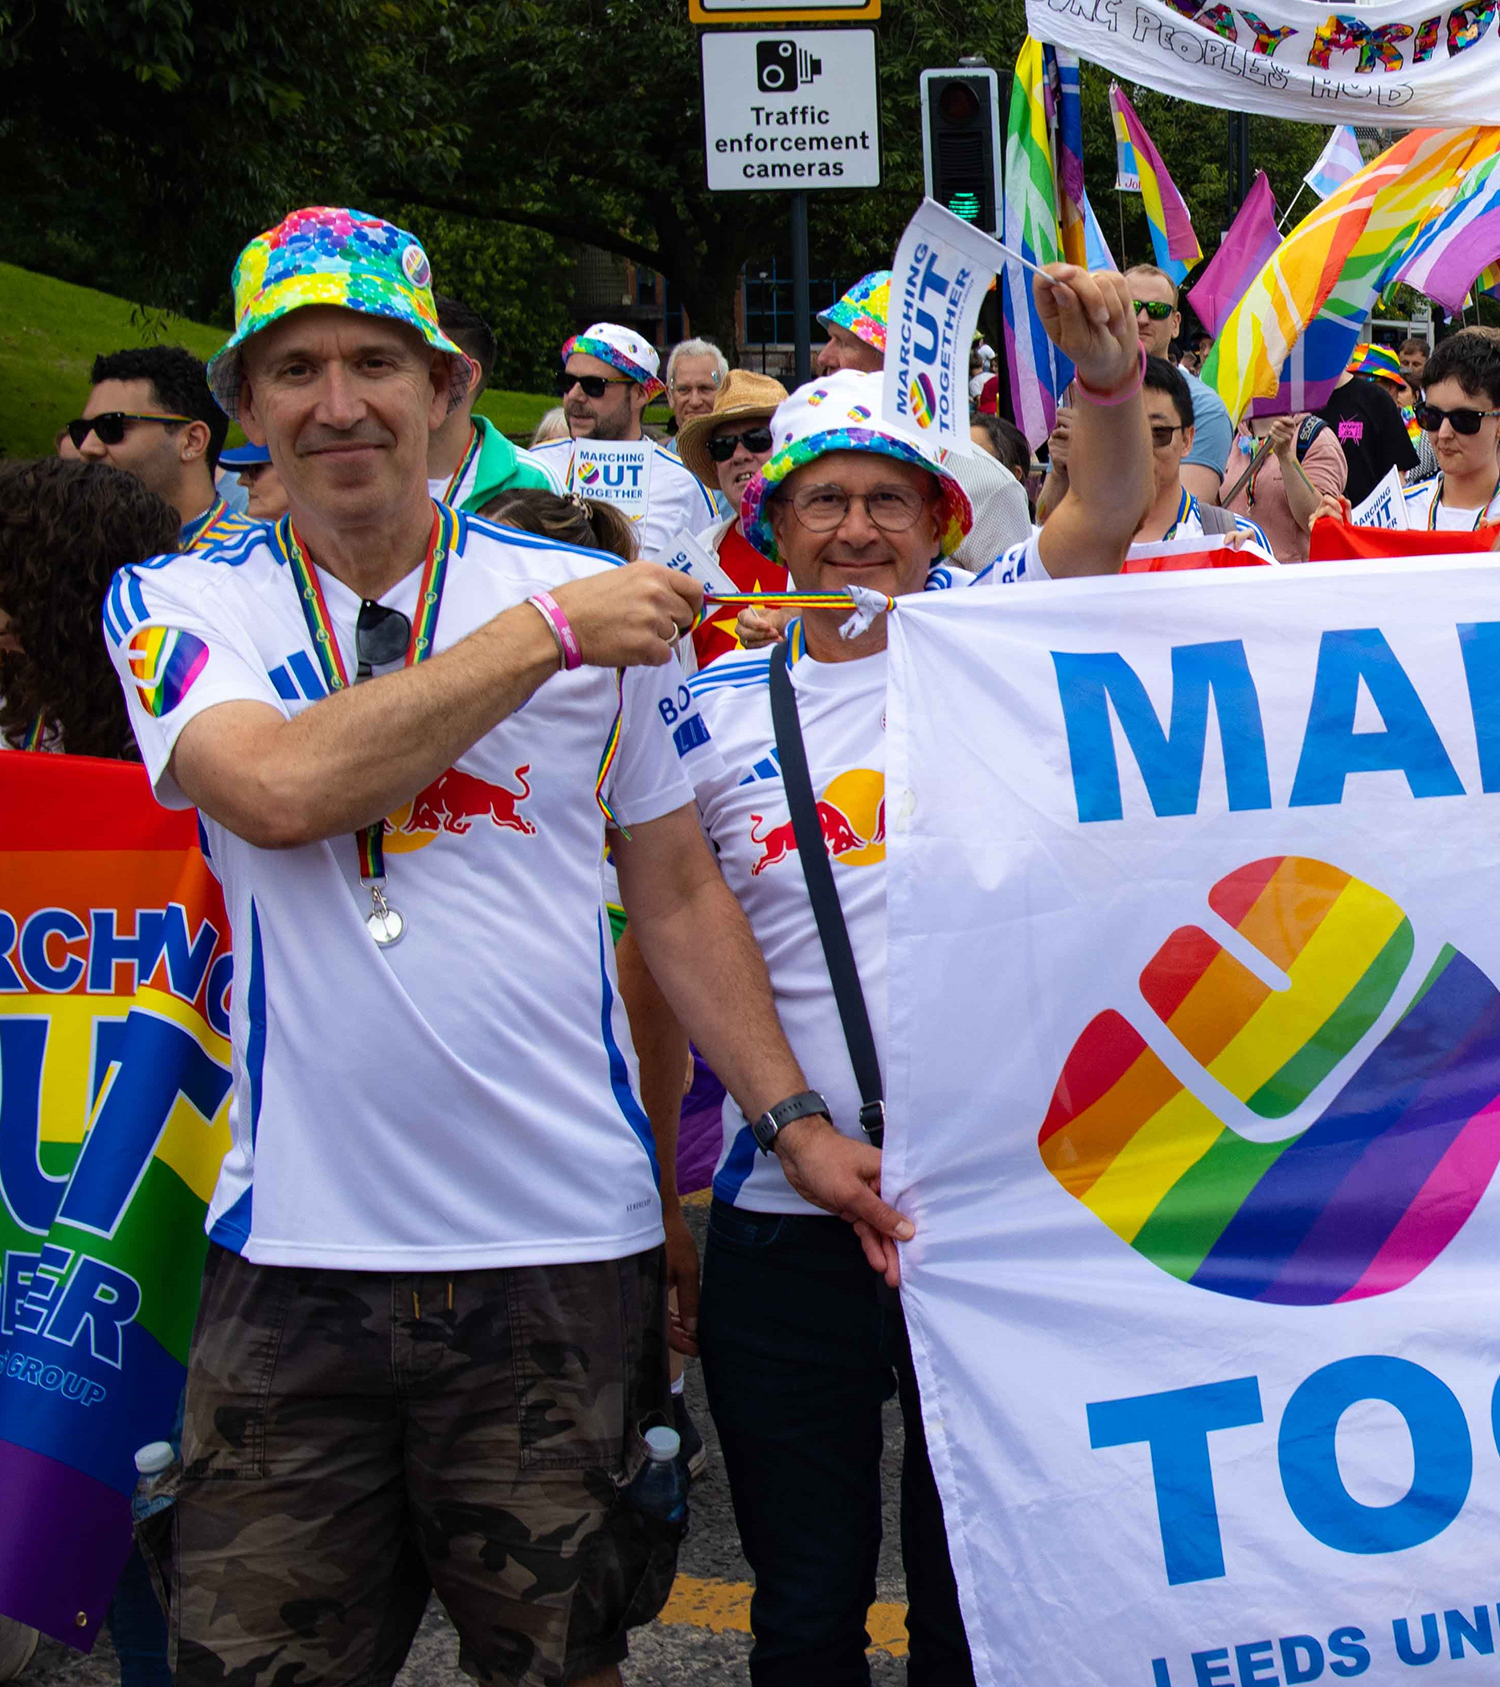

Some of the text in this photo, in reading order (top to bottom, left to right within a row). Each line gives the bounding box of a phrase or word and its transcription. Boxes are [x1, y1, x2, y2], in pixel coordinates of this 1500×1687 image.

[1133, 7, 1291, 90] PEOPLES
[751, 106, 830, 125] Traffic
[715, 131, 870, 153] enforcement
[742, 162, 844, 178] cameras
[896, 242, 929, 416] MARCHING
[939, 267, 972, 434] TOGETHER
[579, 450, 645, 462] MARCHING
[579, 486, 643, 500] TOGETHER
[7, 1352, 106, 1407] GROUP
[1151, 1626, 1371, 1687] LEEDS
